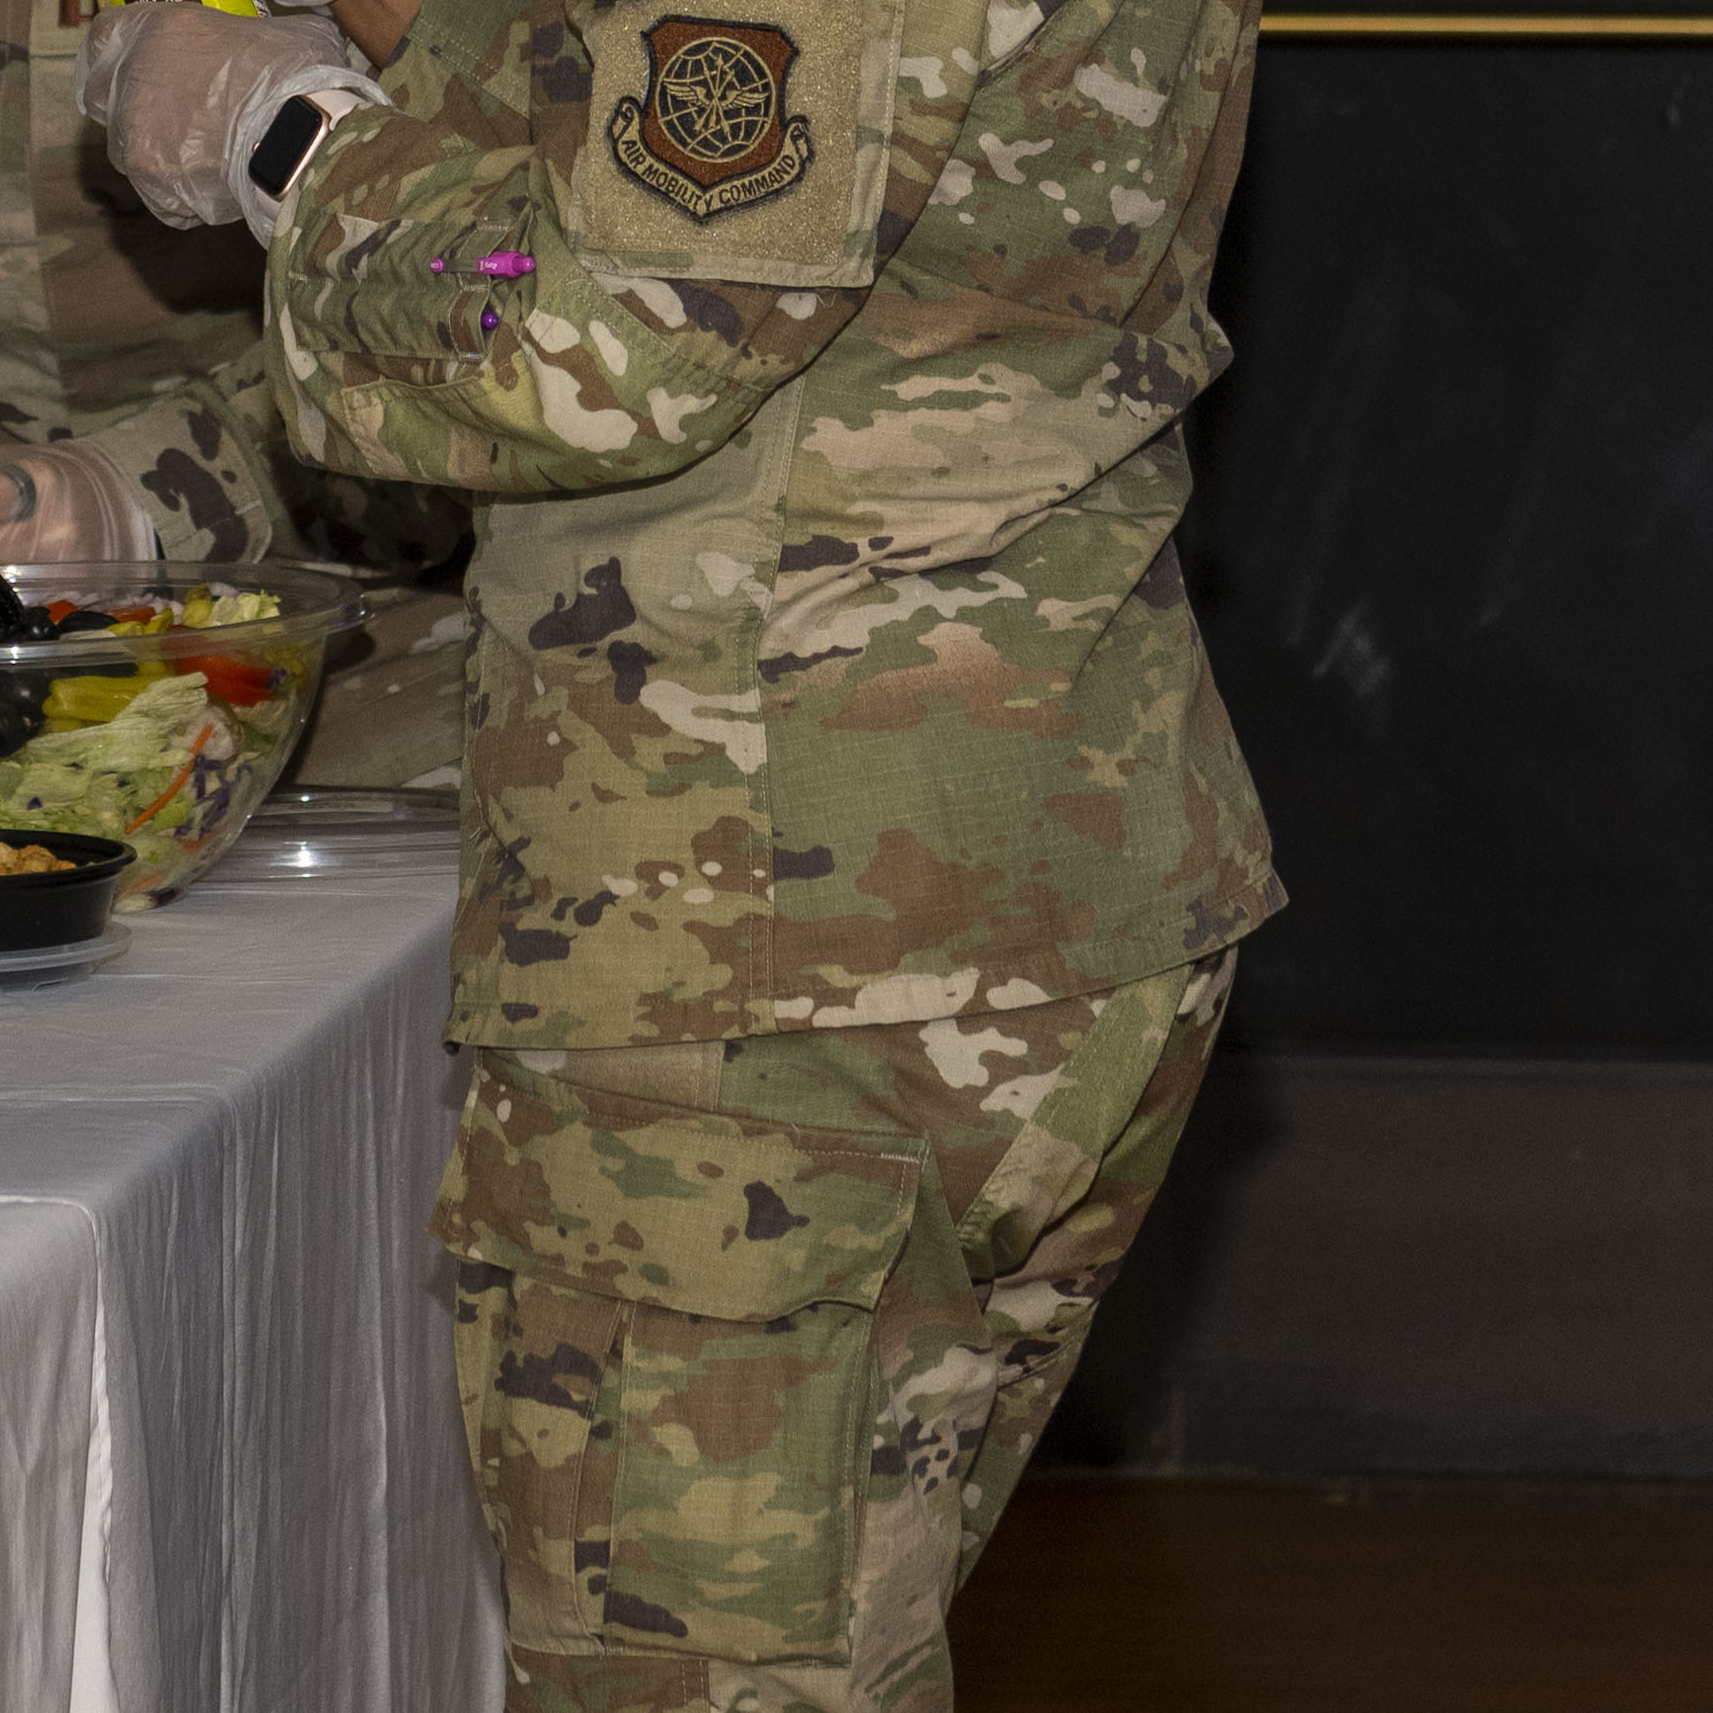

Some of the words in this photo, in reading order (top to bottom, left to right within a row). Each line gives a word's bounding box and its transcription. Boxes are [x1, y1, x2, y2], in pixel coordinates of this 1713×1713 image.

[622, 139, 645, 170] AIR
[642, 163, 714, 212] MOBILITY
[719, 154, 796, 206] COMMAND
